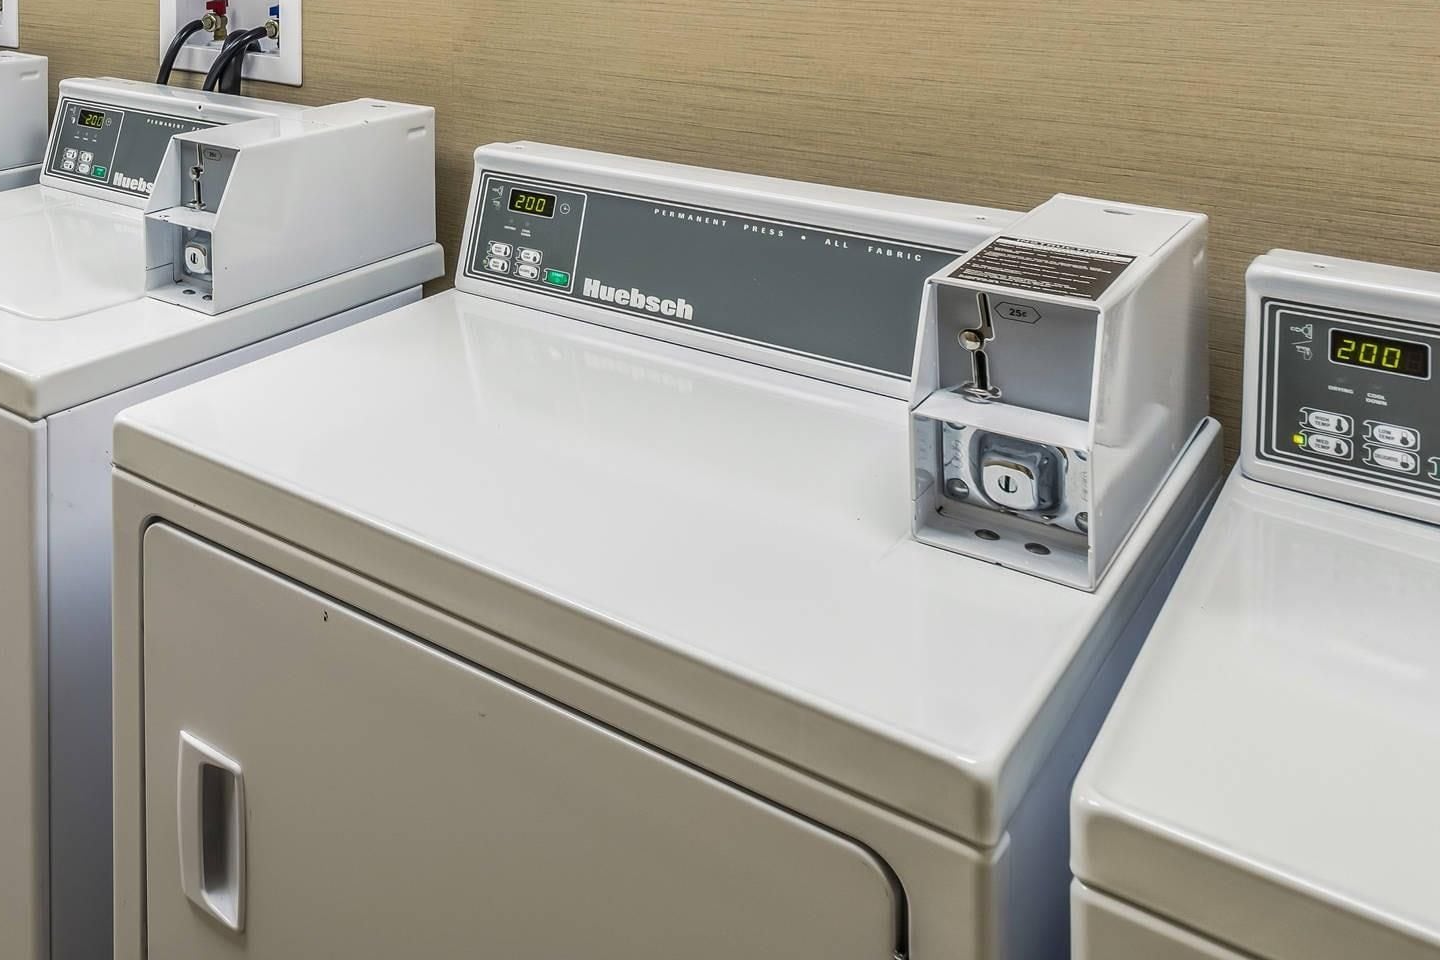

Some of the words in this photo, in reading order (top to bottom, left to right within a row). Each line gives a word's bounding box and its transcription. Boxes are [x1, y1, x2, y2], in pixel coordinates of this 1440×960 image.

[113, 172, 154, 192] Huebs
[515, 195, 546, 212] 200
[654, 208, 728, 227] PERMANENT
[744, 224, 785, 237] PRESS
[824, 238, 849, 249] ALL
[868, 246, 923, 262] FABRIC
[582, 278, 693, 321] Huebsch
[1337, 340, 1401, 368] 200
